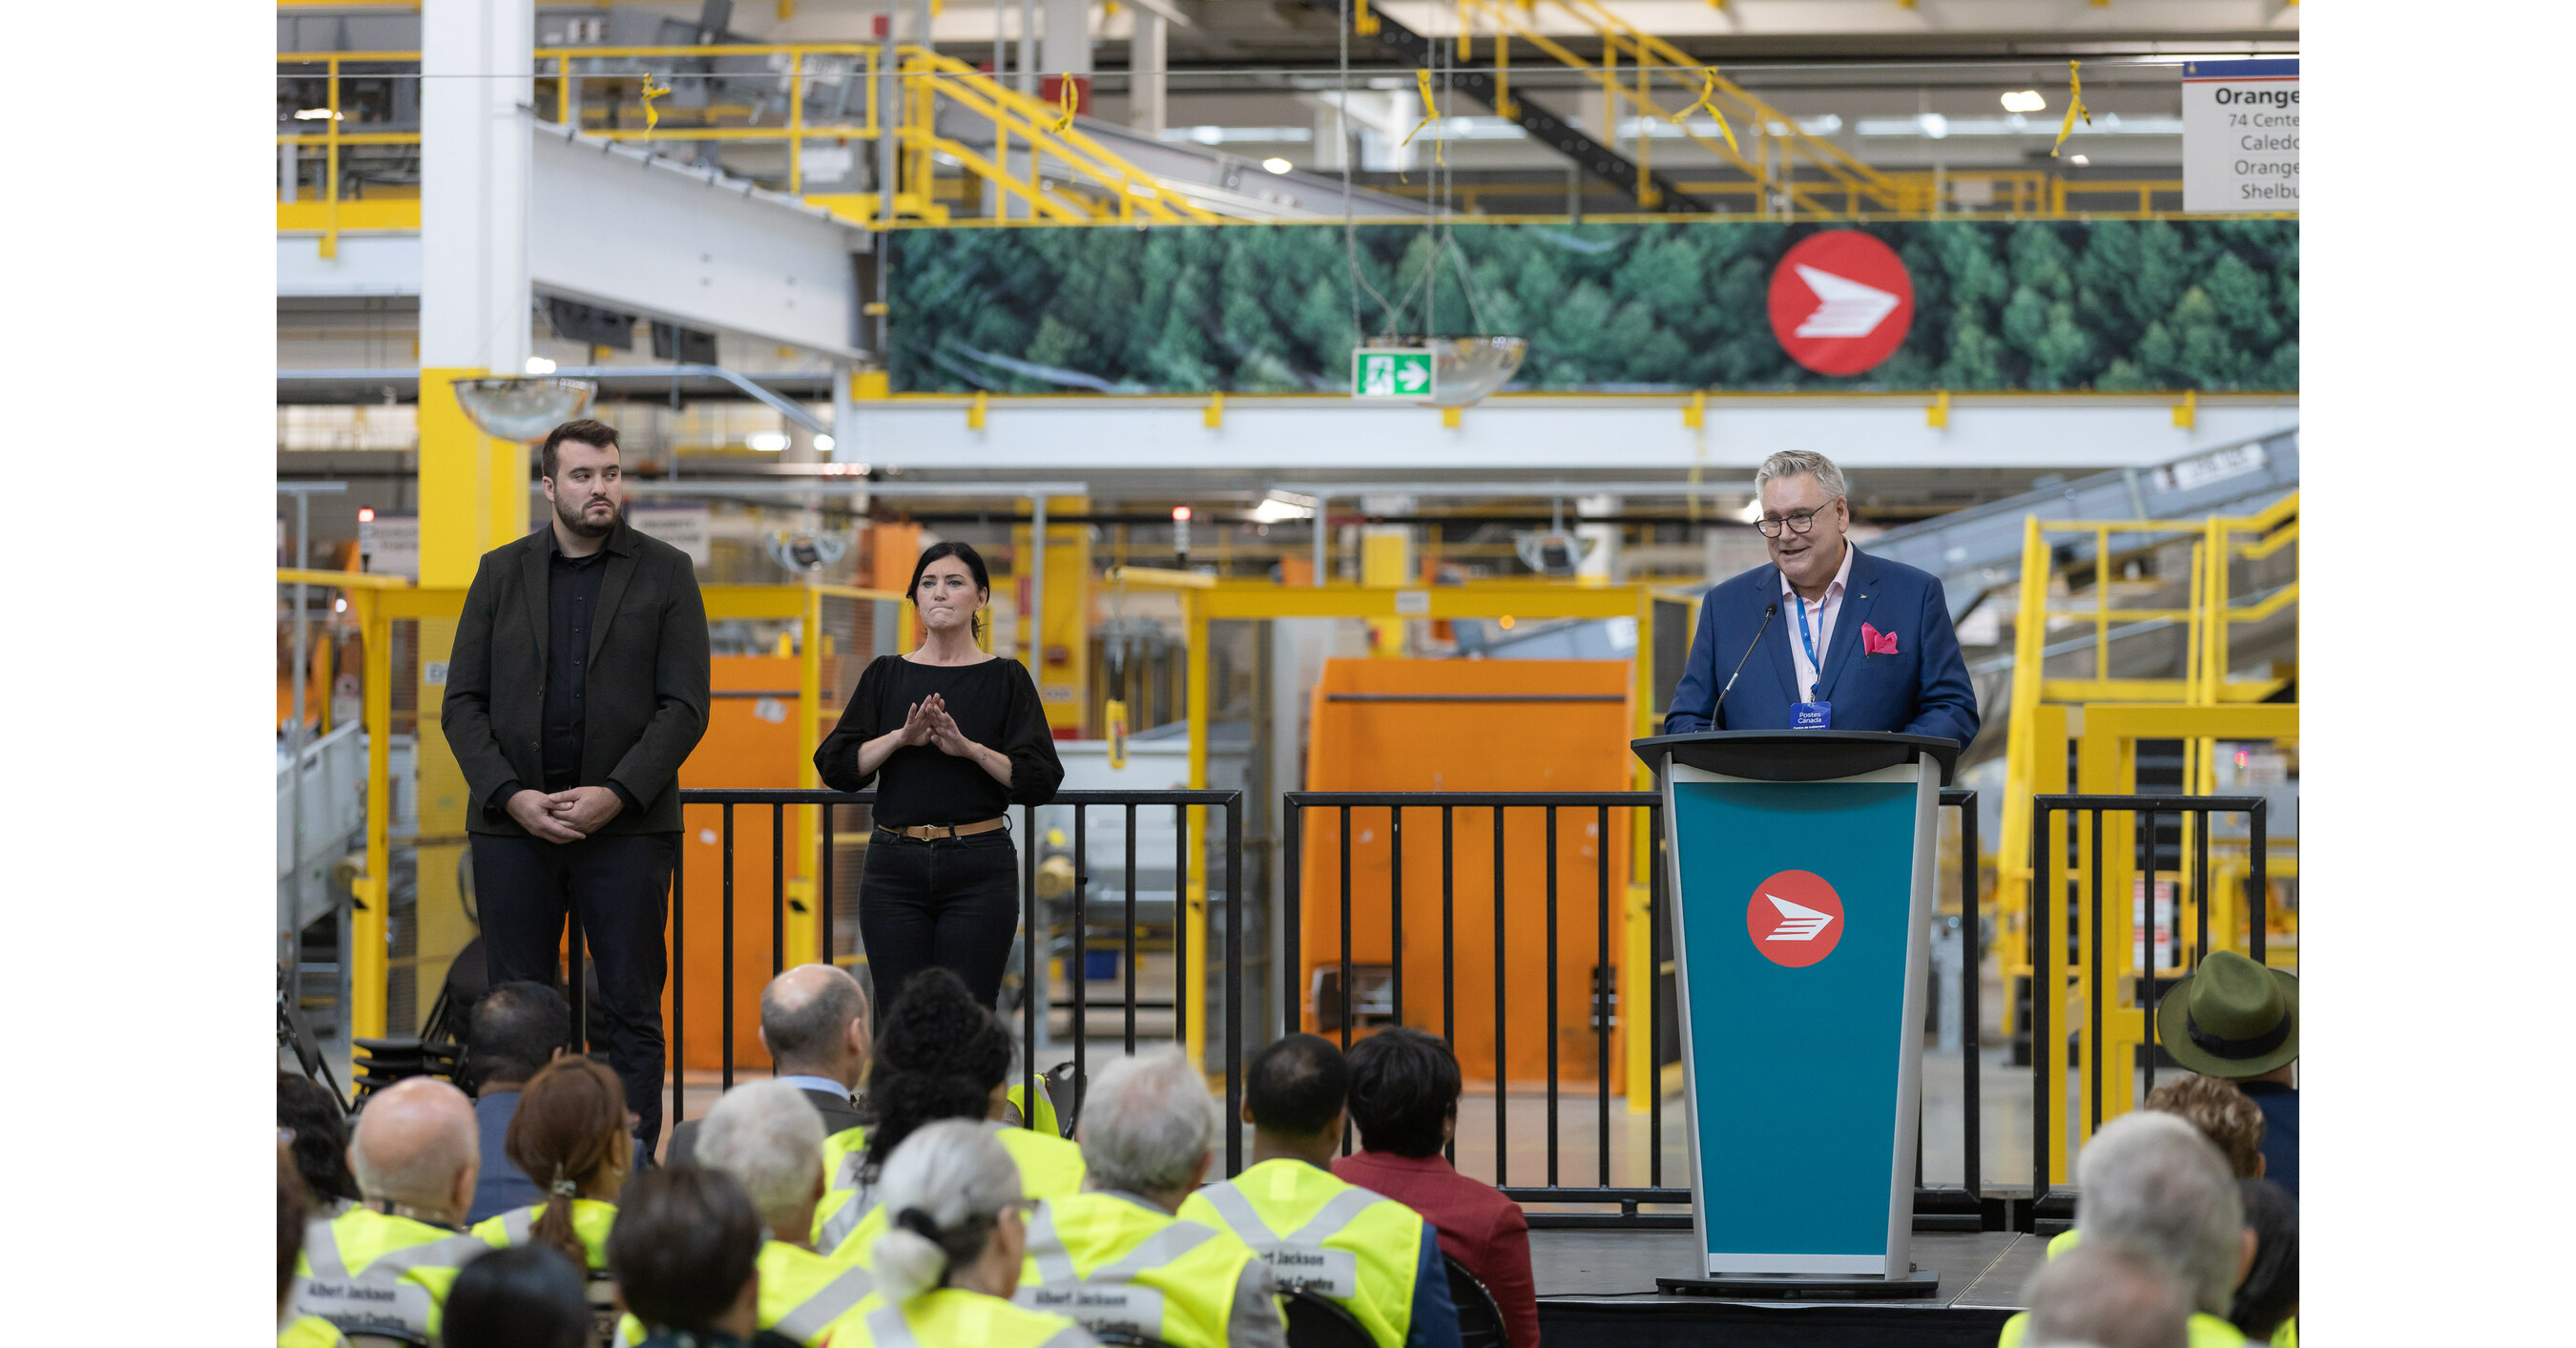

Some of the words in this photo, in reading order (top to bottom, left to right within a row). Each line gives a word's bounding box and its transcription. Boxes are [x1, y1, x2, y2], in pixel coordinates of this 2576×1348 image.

[2215, 88, 2299, 108] Orange
[2229, 114, 2248, 127] 74
[2253, 114, 2299, 127] Cente
[2234, 159, 2299, 178] Orange
[1278, 1251, 1324, 1265] Jackson
